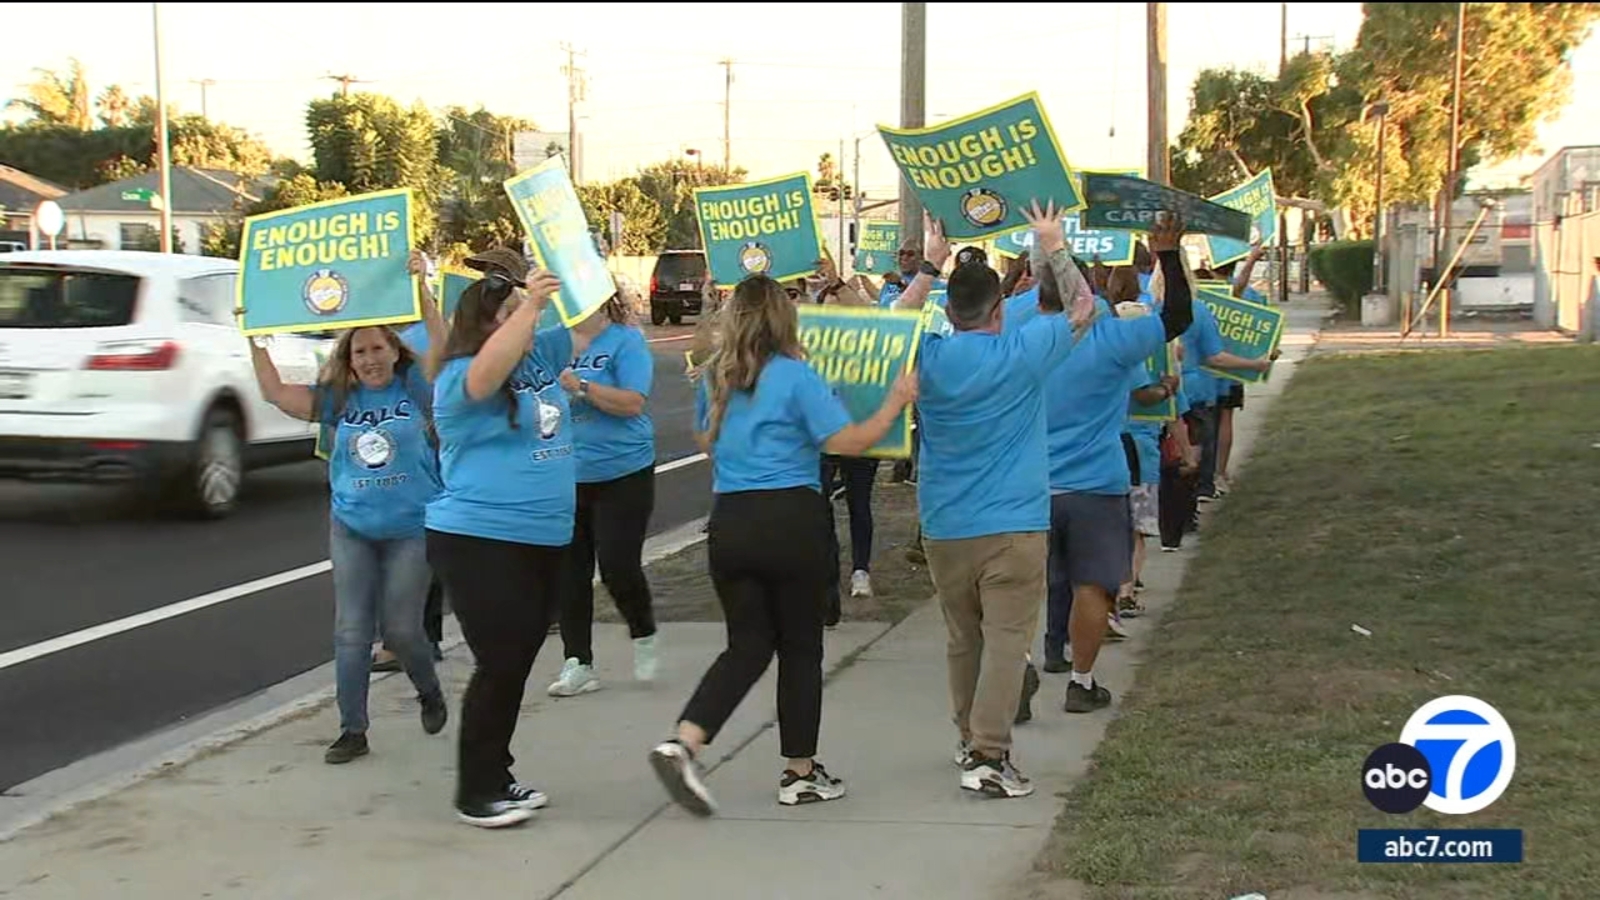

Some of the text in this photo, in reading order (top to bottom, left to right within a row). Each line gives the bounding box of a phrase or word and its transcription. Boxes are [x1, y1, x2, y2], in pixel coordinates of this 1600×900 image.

[891, 118, 1038, 168] ENOUGH IS
[906, 142, 1037, 190] ENOUGH!
[701, 191, 805, 221] ENOUGH IS
[709, 209, 800, 241] ENOUGH!
[252, 210, 400, 250] ENOUGH IS
[259, 233, 390, 271] ENOUGH!
[1256, 319, 1273, 334] IS
